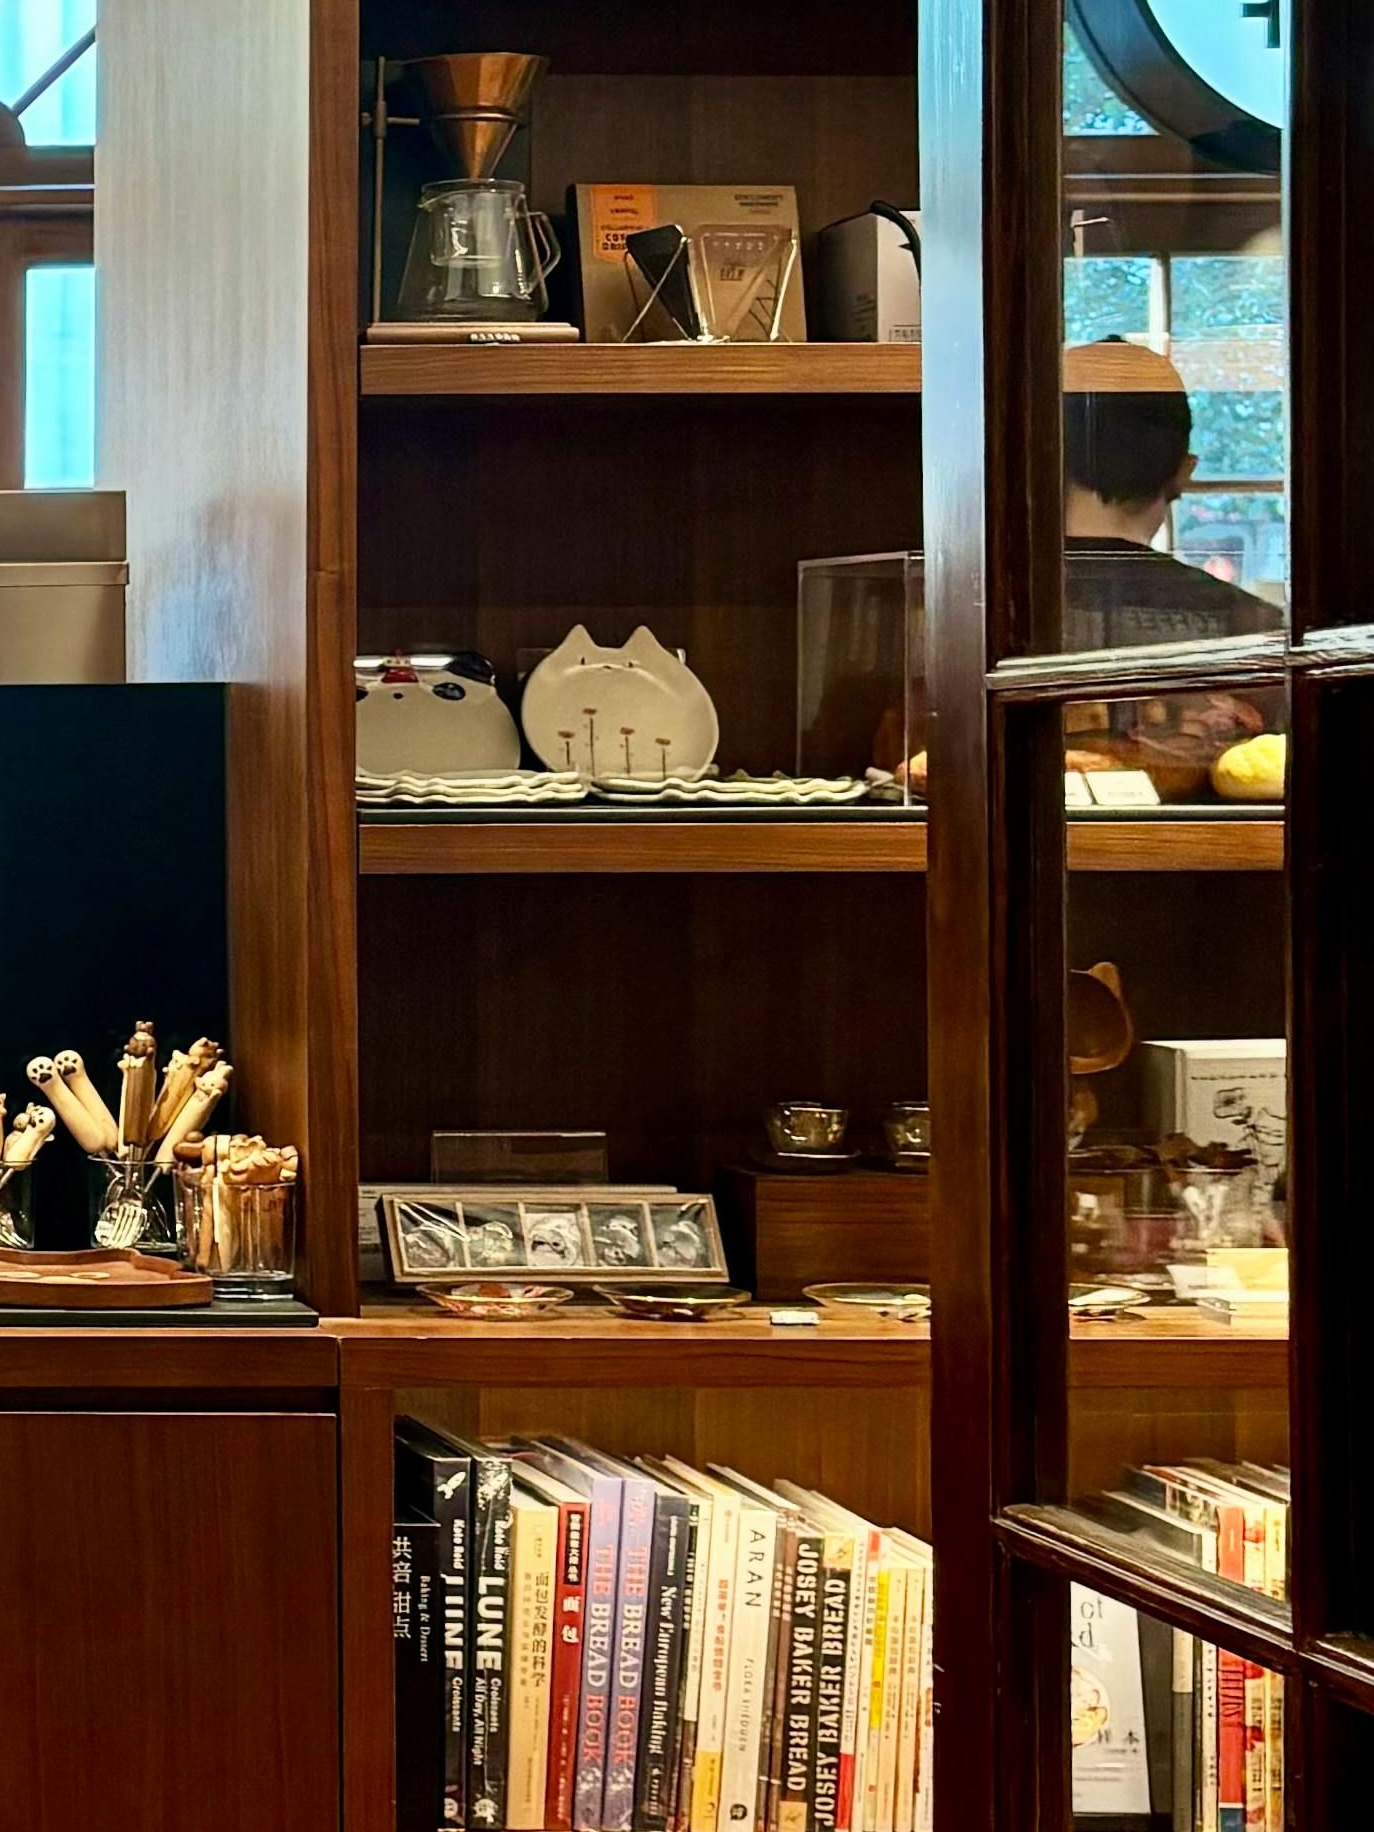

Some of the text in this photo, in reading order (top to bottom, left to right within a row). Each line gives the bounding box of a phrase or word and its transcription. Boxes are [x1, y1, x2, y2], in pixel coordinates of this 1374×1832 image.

[451, 1519, 464, 1570] Kate Reid
[493, 1520, 505, 1570] Kate Reid
[745, 1529, 767, 1608] ARAN
[418, 1575, 431, 1610] Baking
[476, 1576, 504, 1671] LUNE
[561, 1596, 581, 1643] 面包
[660, 1585, 678, 1619] New
[419, 1626, 430, 1662] Dessert
[532, 1571, 550, 1687] 面包发酵的科学
[582, 1545, 615, 1764] THE BREAD BOOK
[613, 1545, 648, 1766] THE BREAD BOOK
[654, 1622, 673, 1696] European
[785, 1544, 818, 1792] JOSEY BAKER BREAD
[451, 1676, 462, 1733] Croissants
[472, 1676, 486, 1766] All Day, All Night
[488, 1677, 501, 1733] Croissants
[648, 1700, 669, 1755] Baking
[814, 1579, 846, 1827] JOSEY BAKER BREAD
